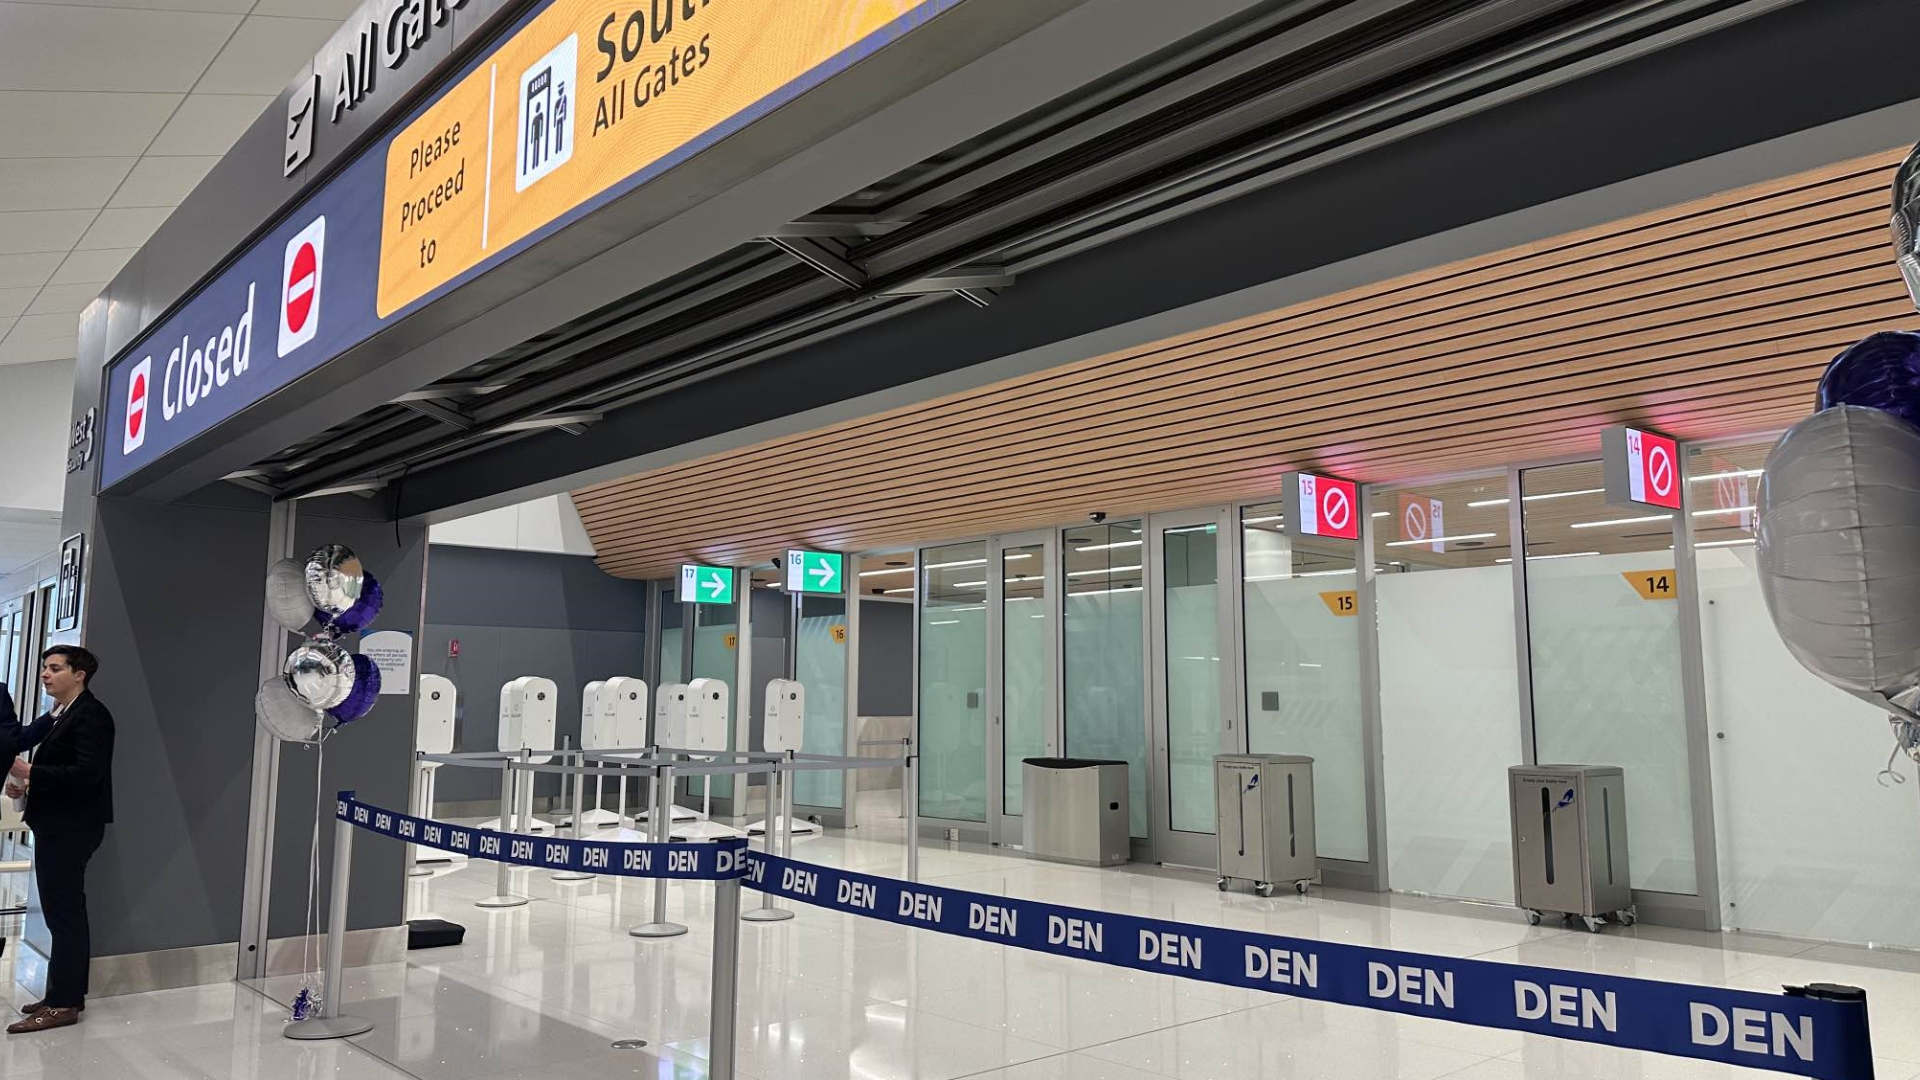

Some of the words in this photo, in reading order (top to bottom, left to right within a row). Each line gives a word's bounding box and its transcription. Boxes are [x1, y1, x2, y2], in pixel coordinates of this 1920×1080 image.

[331, 21, 377, 123] All
[382, 0, 469, 70] Ga
[597, 0, 709, 83] Sou
[592, 79, 625, 137] All
[634, 33, 709, 108] Gates
[410, 121, 461, 180] Please
[401, 157, 465, 232] Proceed
[420, 238, 436, 269] to
[162, 282, 256, 421] Closed
[84, 407, 96, 462] 3
[1628, 435, 1641, 456] 14
[1301, 479, 1313, 496] 15
[684, 568, 695, 579] 17
[789, 554, 802, 565] 16
[1337, 596, 1353, 610] 15
[1646, 576, 1670, 593] 14
[728, 636, 736, 646] 17
[835, 629, 844, 639] 16
[337, 801, 348, 816] EN
[354, 806, 369, 824] DEN
[375, 813, 391, 831] DEN
[399, 820, 416, 837] DEN
[424, 825, 442, 843] DEN
[450, 831, 470, 849] DEN
[480, 836, 500, 854] DEN
[511, 840, 533, 859] DEN
[546, 844, 569, 863] DEN
[583, 847, 608, 867] DEN
[624, 850, 651, 870] DEN
[669, 851, 698, 871] DEN
[716, 847, 746, 872] DE
[742, 858, 766, 883] EN
[782, 868, 817, 896] DEN
[837, 879, 876, 909] DEN
[899, 891, 942, 922] DEN
[969, 903, 1016, 936] DEN
[1048, 915, 1102, 952] DEN
[1139, 930, 1201, 969] DEN
[1245, 945, 1317, 988] DEN
[1369, 962, 1454, 1008] DEN
[1514, 980, 1616, 1032] DEN
[1690, 1002, 1813, 1061] DEN
